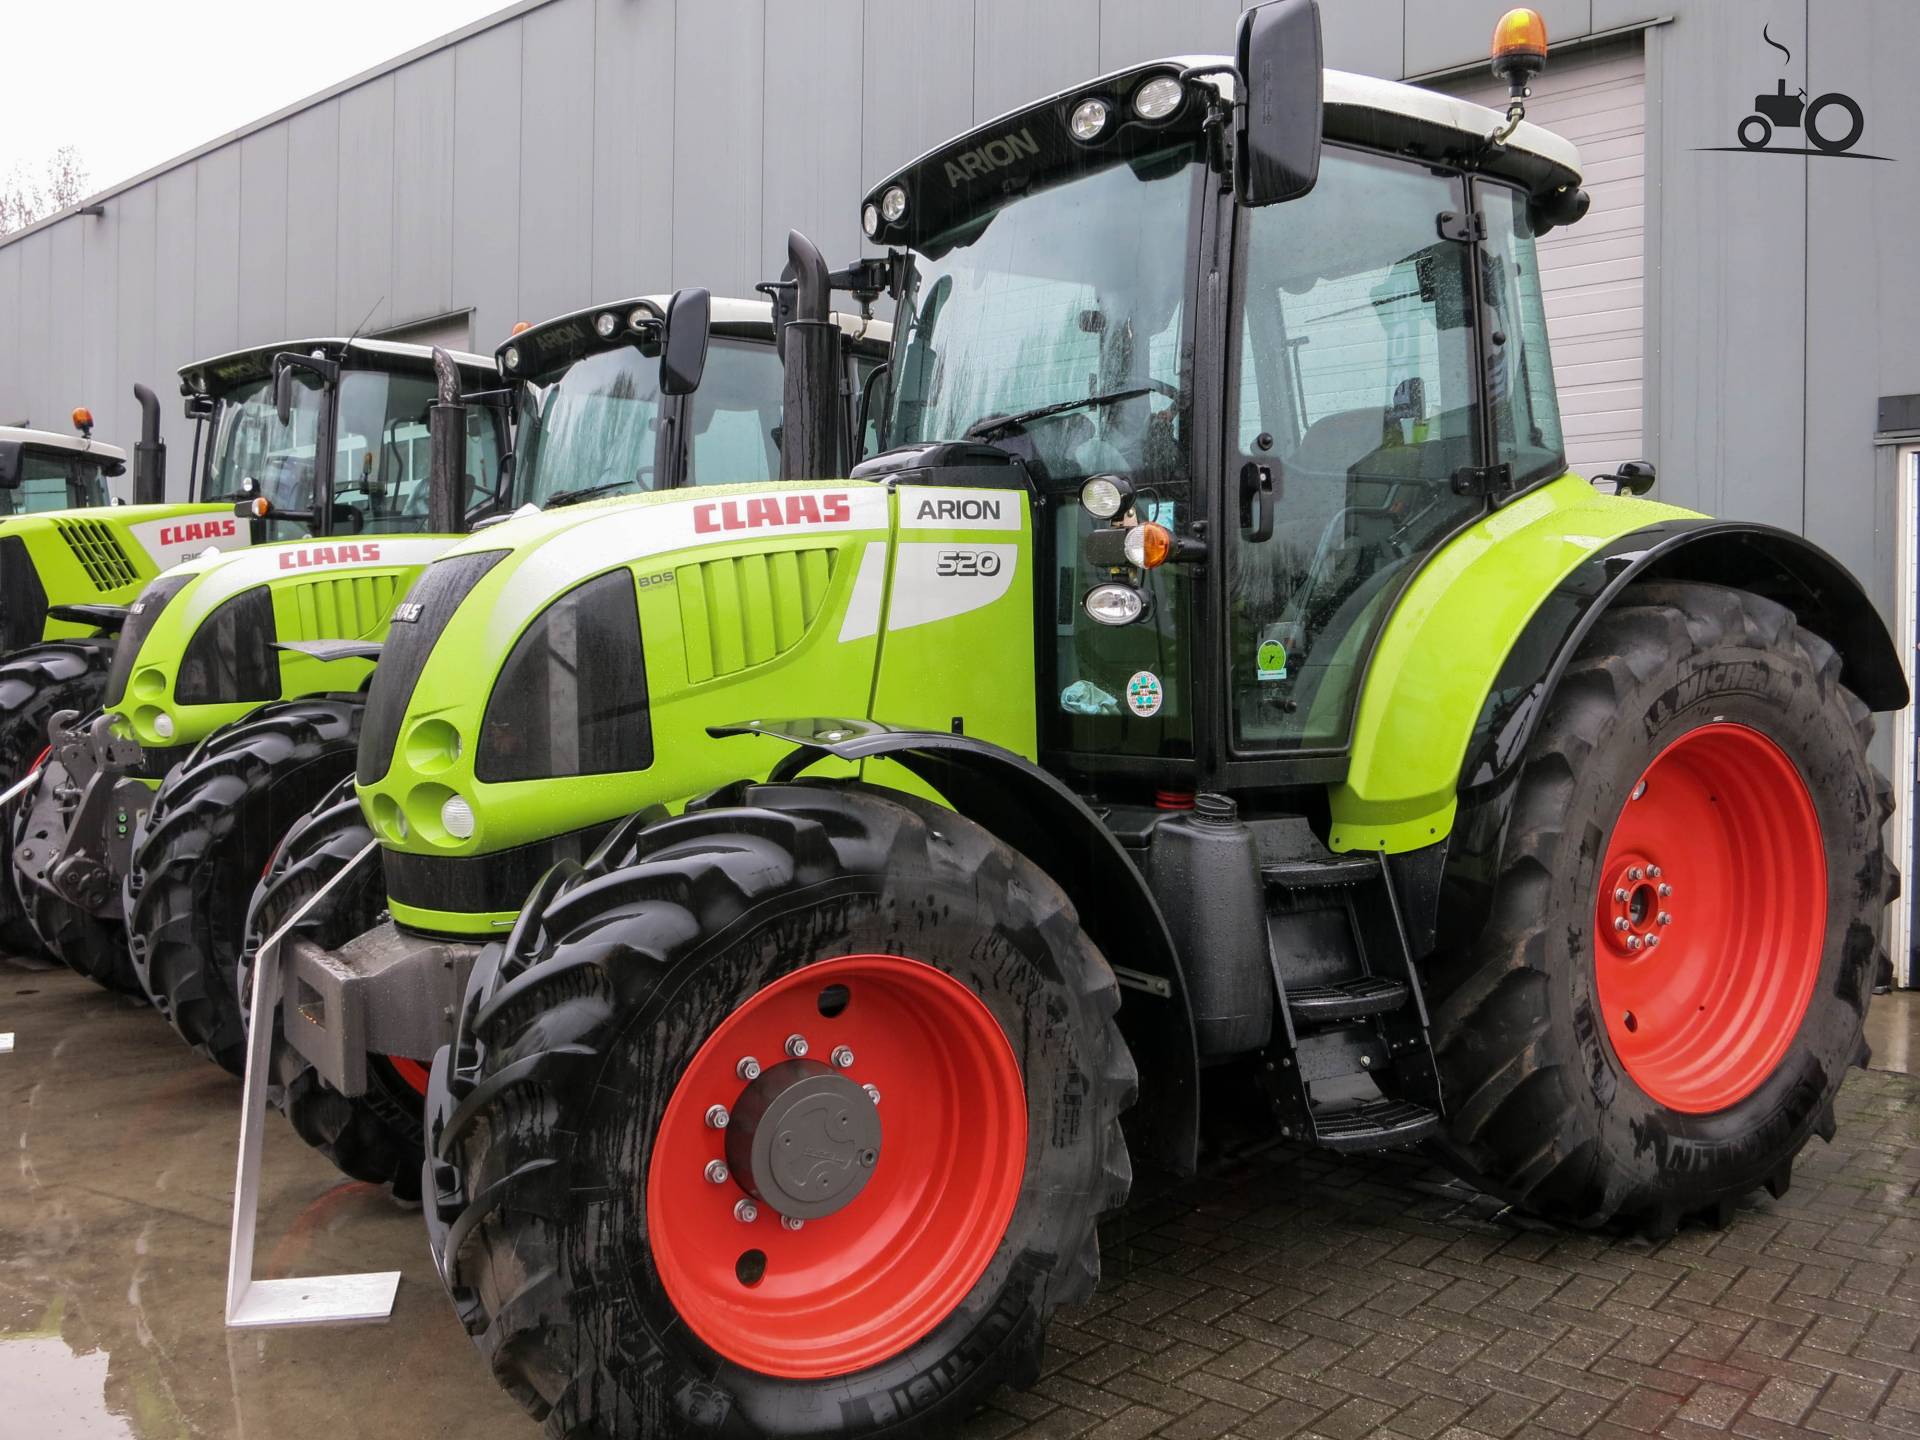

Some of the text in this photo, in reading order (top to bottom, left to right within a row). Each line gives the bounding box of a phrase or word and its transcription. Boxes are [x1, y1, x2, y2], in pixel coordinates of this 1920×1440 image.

[944, 128, 1040, 188] ARION
[535, 323, 585, 352] ARION
[693, 494, 850, 534] CLAAS
[917, 500, 1000, 520] ARION
[160, 520, 235, 545] CLAAS
[279, 544, 380, 570] CLAAS
[936, 551, 1000, 576] 520
